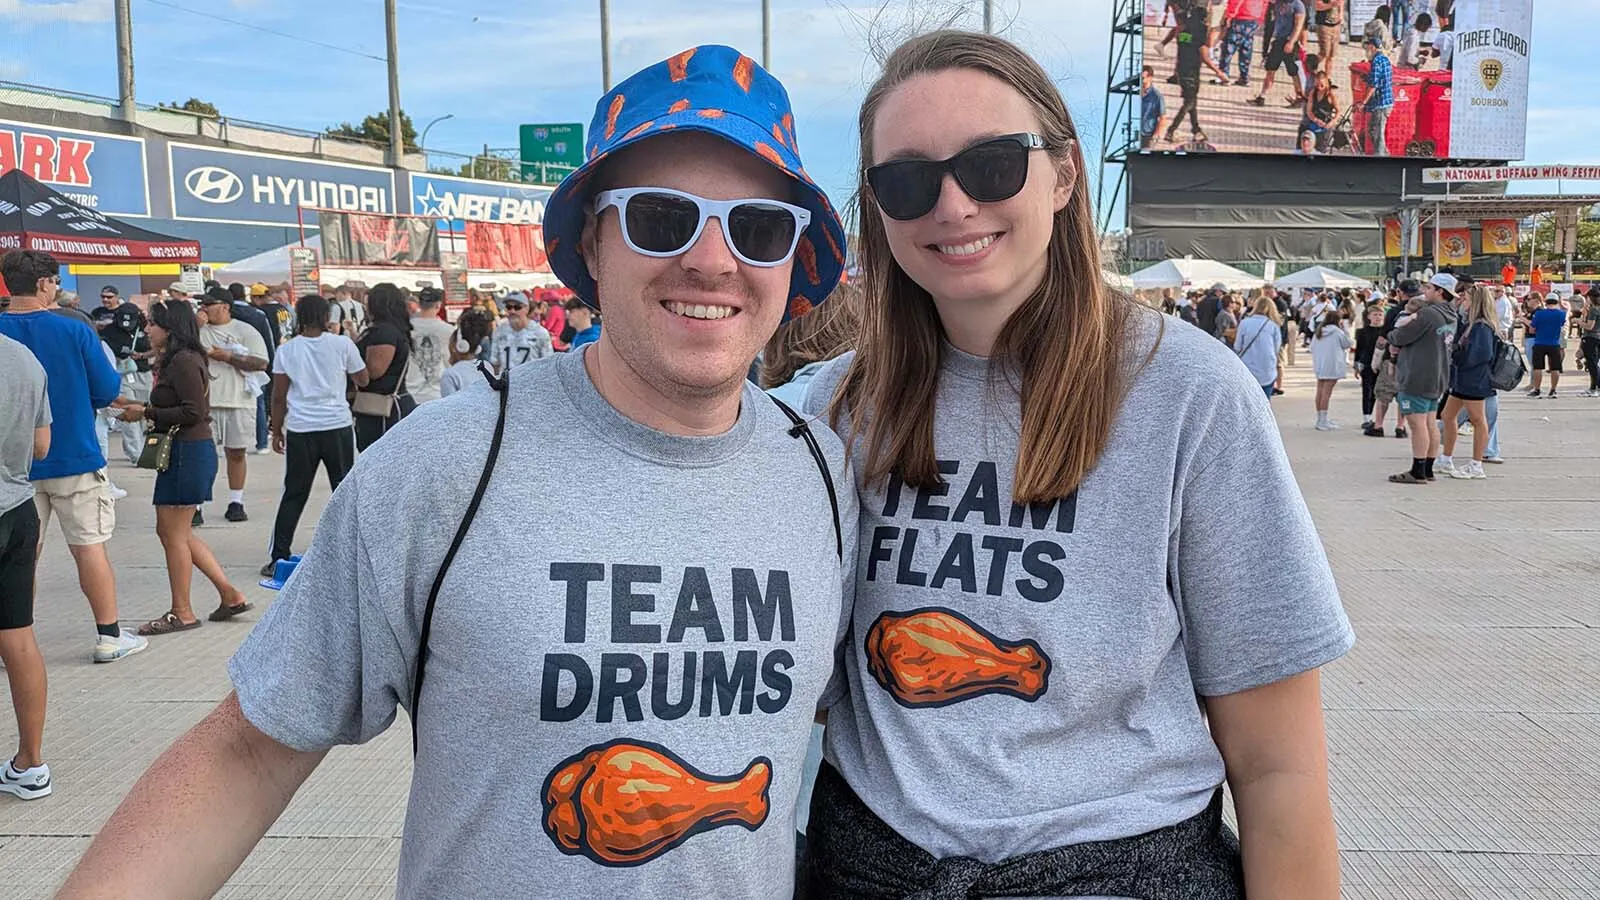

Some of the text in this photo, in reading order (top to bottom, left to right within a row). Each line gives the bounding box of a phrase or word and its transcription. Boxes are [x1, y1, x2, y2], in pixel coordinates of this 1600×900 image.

[1457, 27, 1527, 57] THREE CHORD
[1471, 97, 1508, 106] BOURBON
[1445, 170, 1491, 180] NATIONAL
[1496, 168, 1537, 179] BUFFALO
[1542, 167, 1568, 178] WING
[252, 174, 387, 213] HYUNDAI
[442, 191, 545, 226] NBT BAN
[0, 235, 21, 249] 905
[31, 238, 131, 257] OLDUNIONHOTEL.COM
[504, 346, 531, 369] 17
[867, 526, 1066, 602] FLATS
[550, 562, 796, 643] TEAM
[540, 649, 795, 723] DRUMS
